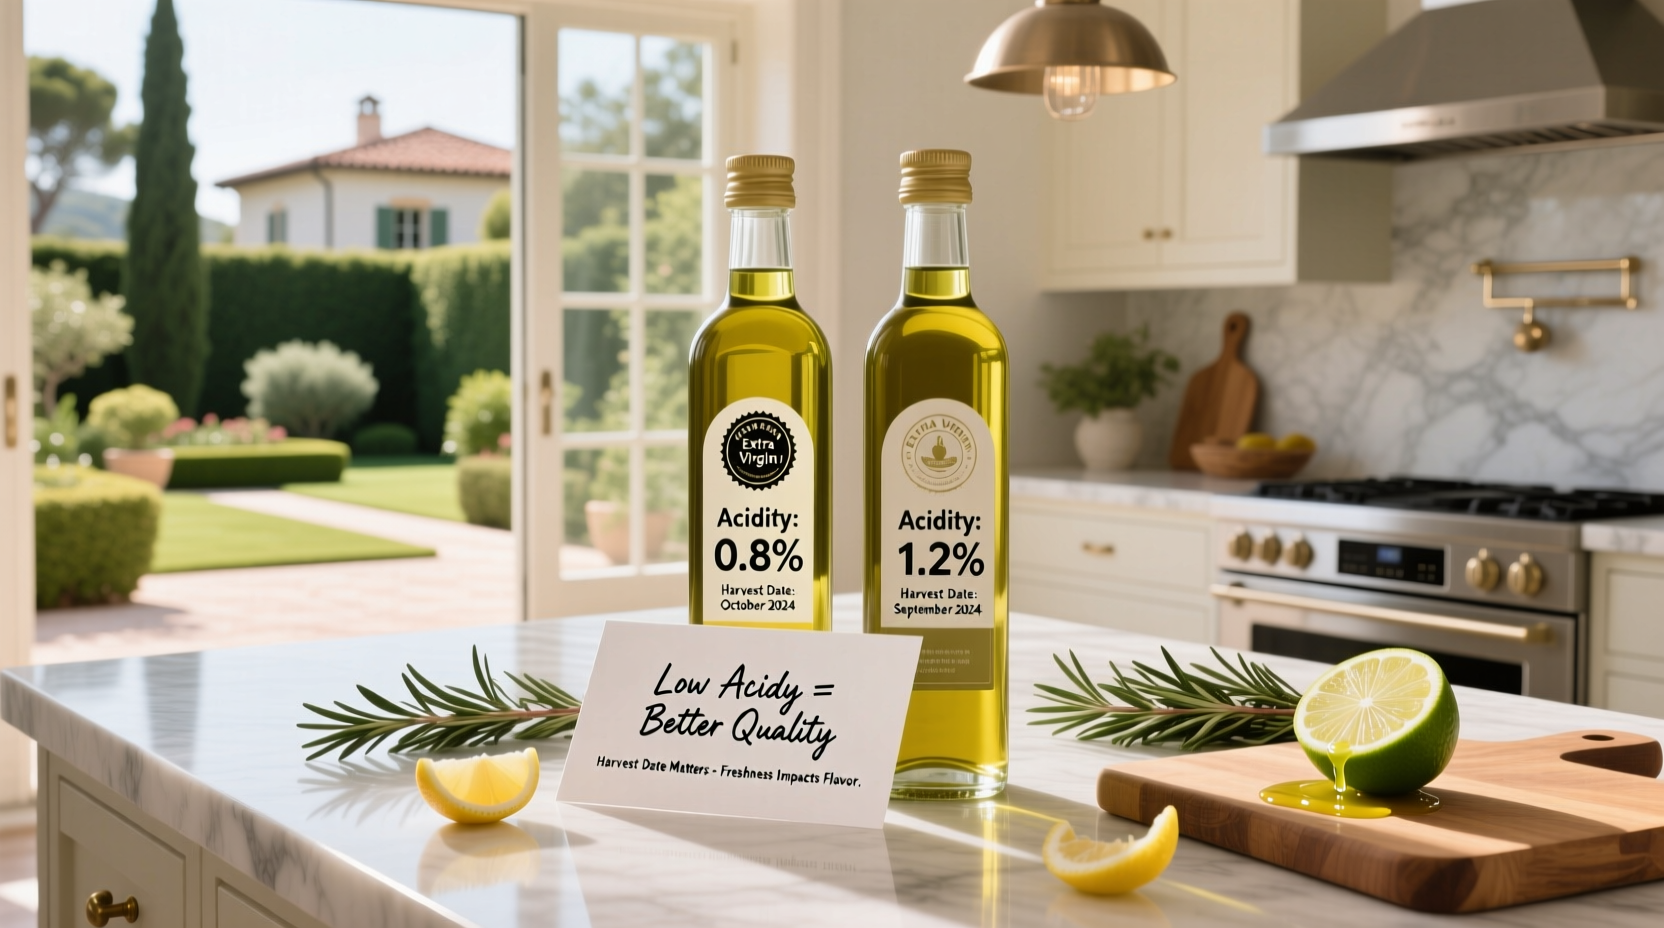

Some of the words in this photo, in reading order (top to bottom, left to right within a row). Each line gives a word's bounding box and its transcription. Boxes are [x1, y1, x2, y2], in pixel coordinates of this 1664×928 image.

[717, 507, 798, 533] Acidity:
[898, 509, 980, 536] Acidity:
[715, 538, 803, 572] 0.8%
[899, 542, 984, 576] 1.2%
[721, 583, 764, 596] Harvest
[766, 584, 795, 596] Date:
[900, 587, 944, 600] Harvest
[947, 588, 978, 600] Date:
[720, 598, 766, 611] October
[767, 599, 796, 611] 2024
[893, 602, 954, 620] September
[954, 603, 983, 616] 2024
[654, 663, 710, 696] Low
[718, 663, 803, 716] Acidy
[640, 703, 723, 736] Better
[731, 707, 837, 761] Quality
[596, 755, 639, 770] Harvest
[641, 758, 667, 772] Date
[669, 760, 710, 776] Matters
[720, 764, 773, 781] Freshness
[776, 768, 820, 786] Impacts
[823, 771, 861, 788] Flavor.
